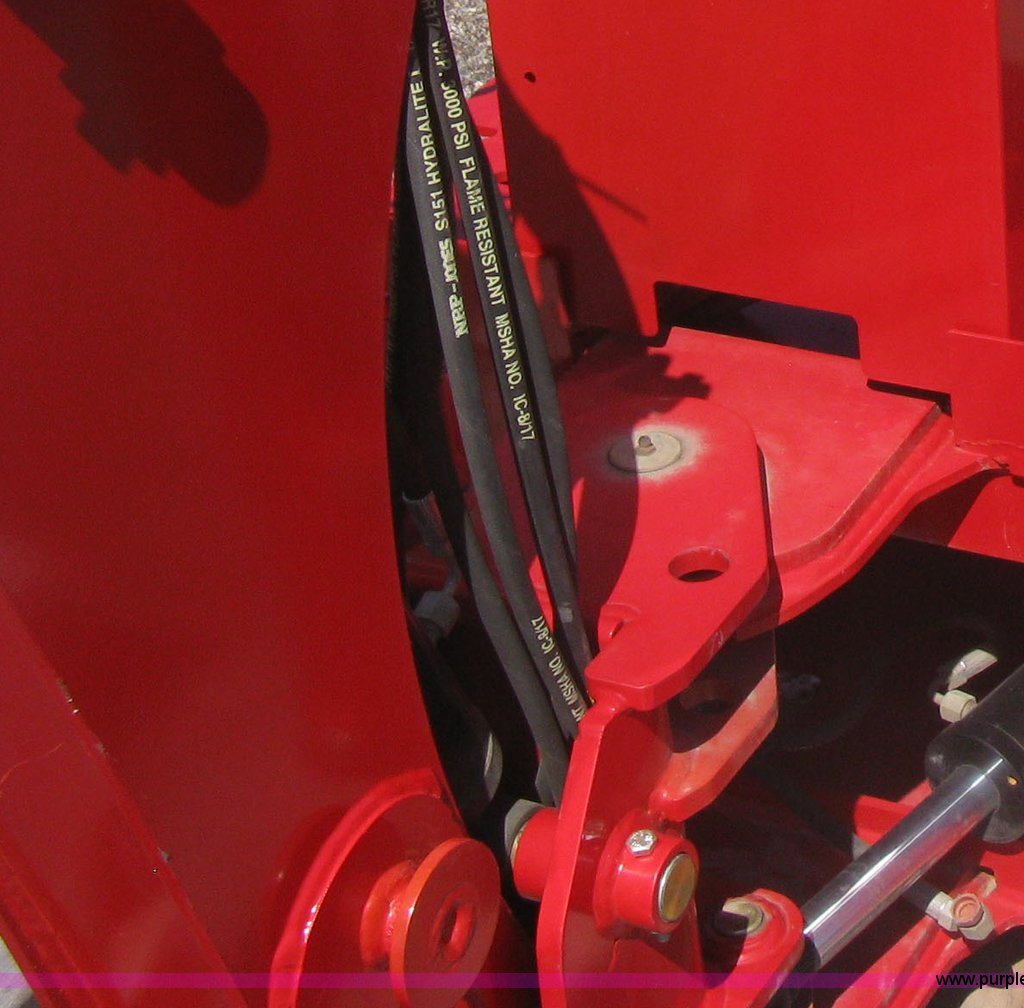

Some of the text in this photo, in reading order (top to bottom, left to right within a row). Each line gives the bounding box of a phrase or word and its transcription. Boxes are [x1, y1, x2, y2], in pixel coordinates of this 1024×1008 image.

[411, 80, 442, 185] HYDRALITE
[451, 120, 471, 150] PSI
[459, 156, 485, 216] FLAME
[430, 190, 449, 231] S151
[473, 216, 506, 306] RESISTANT
[494, 312, 516, 361] MSHA
[505, 360, 523, 390] NO.
[513, 393, 536, 441] IC-8/17
[531, 615, 556, 654] IC-8/17
[548, 651, 566, 676] NO.
[557, 674, 580, 705] MSHA
